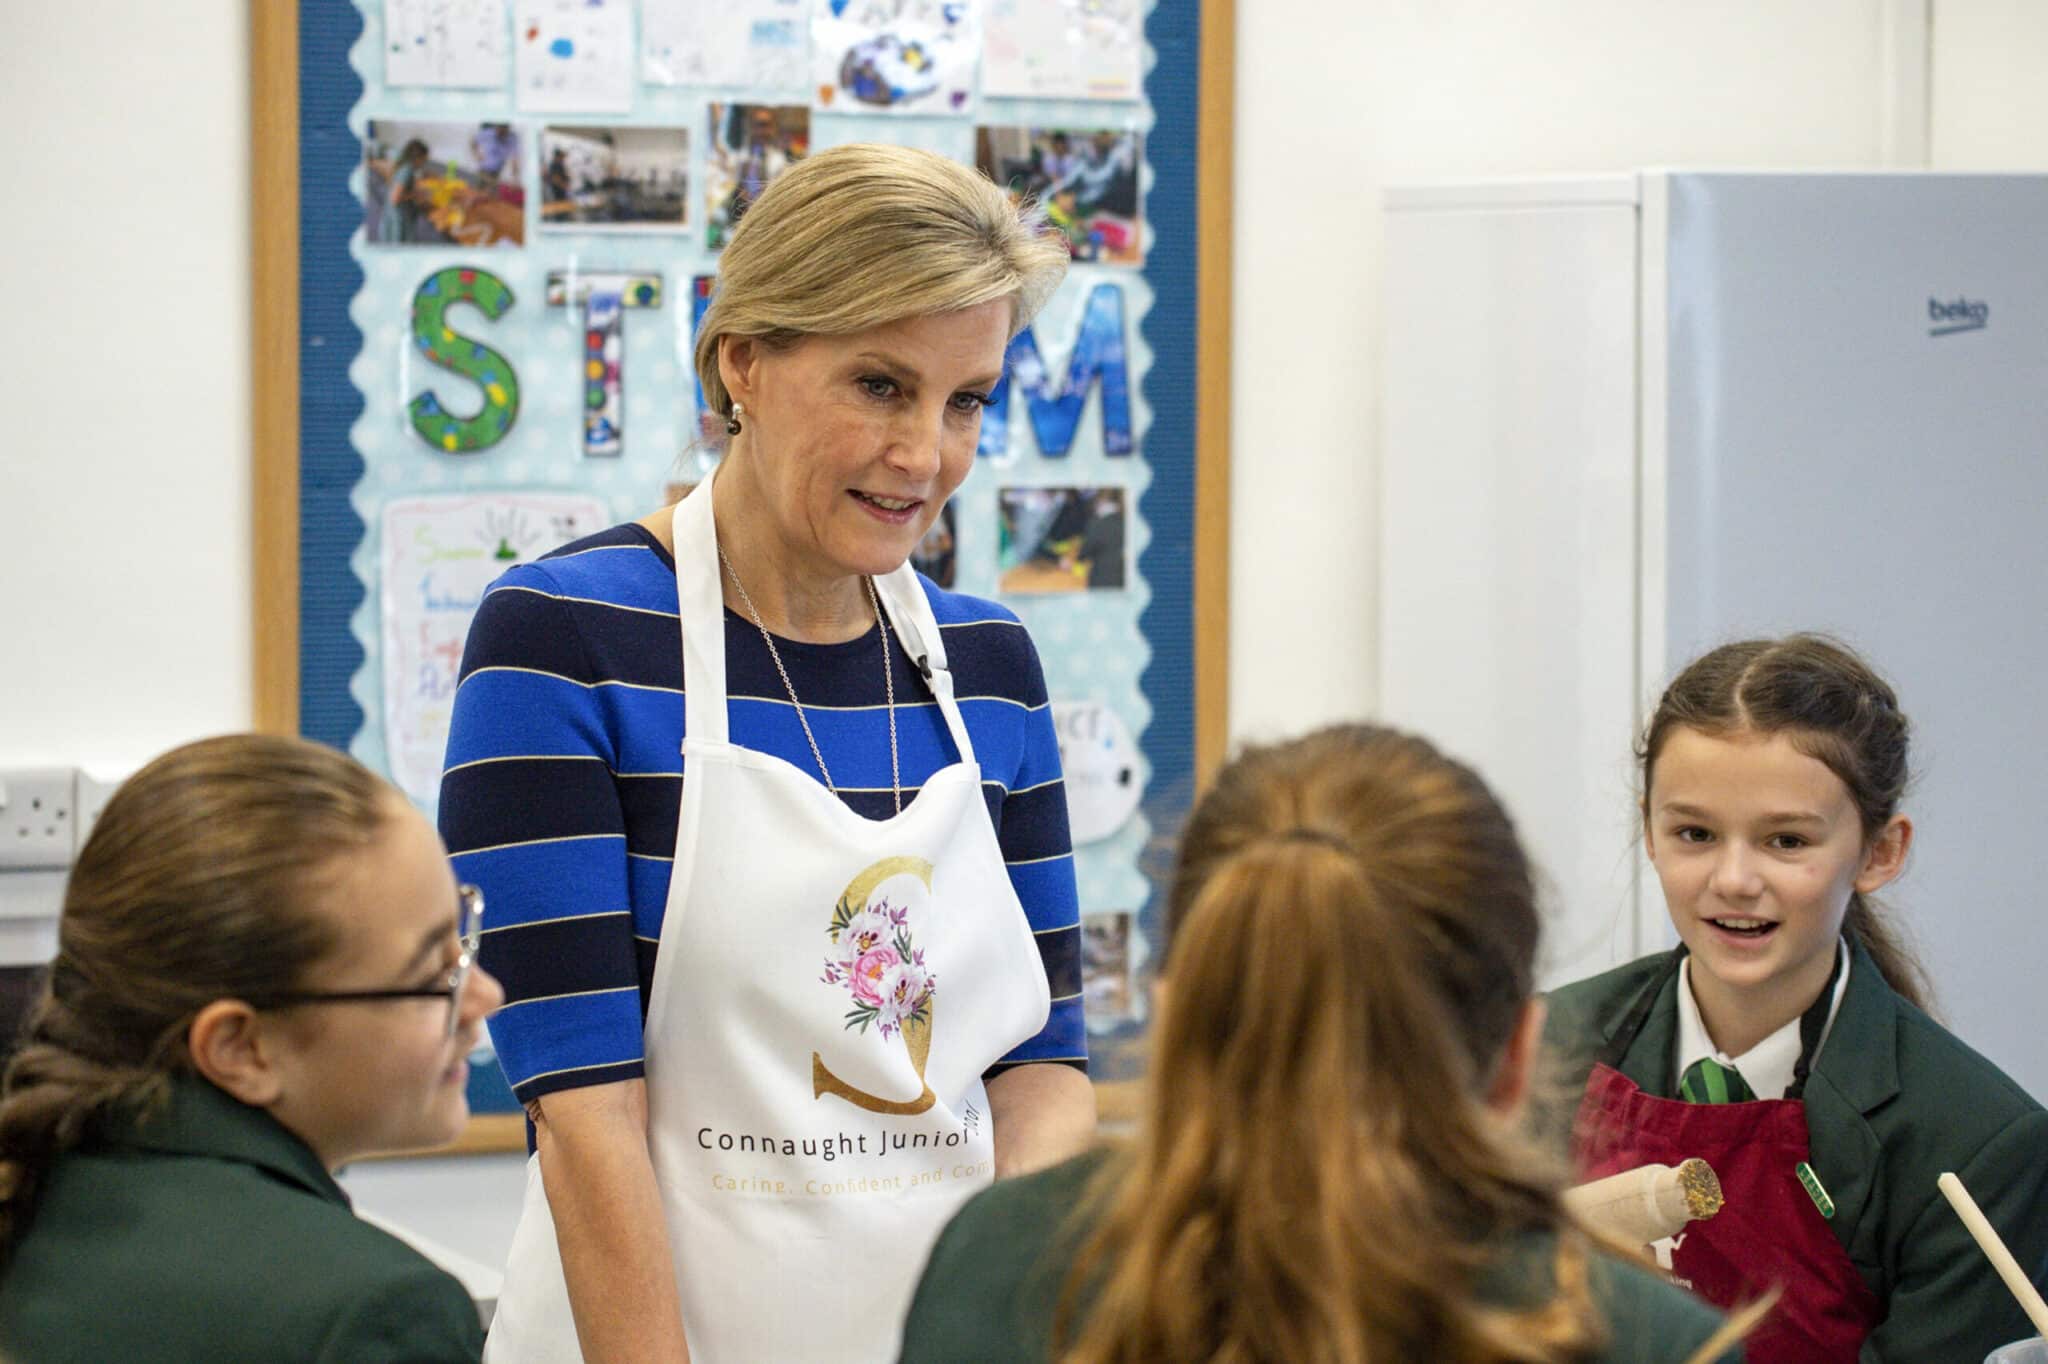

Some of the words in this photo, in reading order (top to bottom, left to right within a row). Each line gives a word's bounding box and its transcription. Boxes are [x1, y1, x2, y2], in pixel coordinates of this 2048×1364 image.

[697, 1127, 867, 1162] Connaught
[805, 1173, 903, 1196] Confident
[911, 1167, 943, 1186] and
